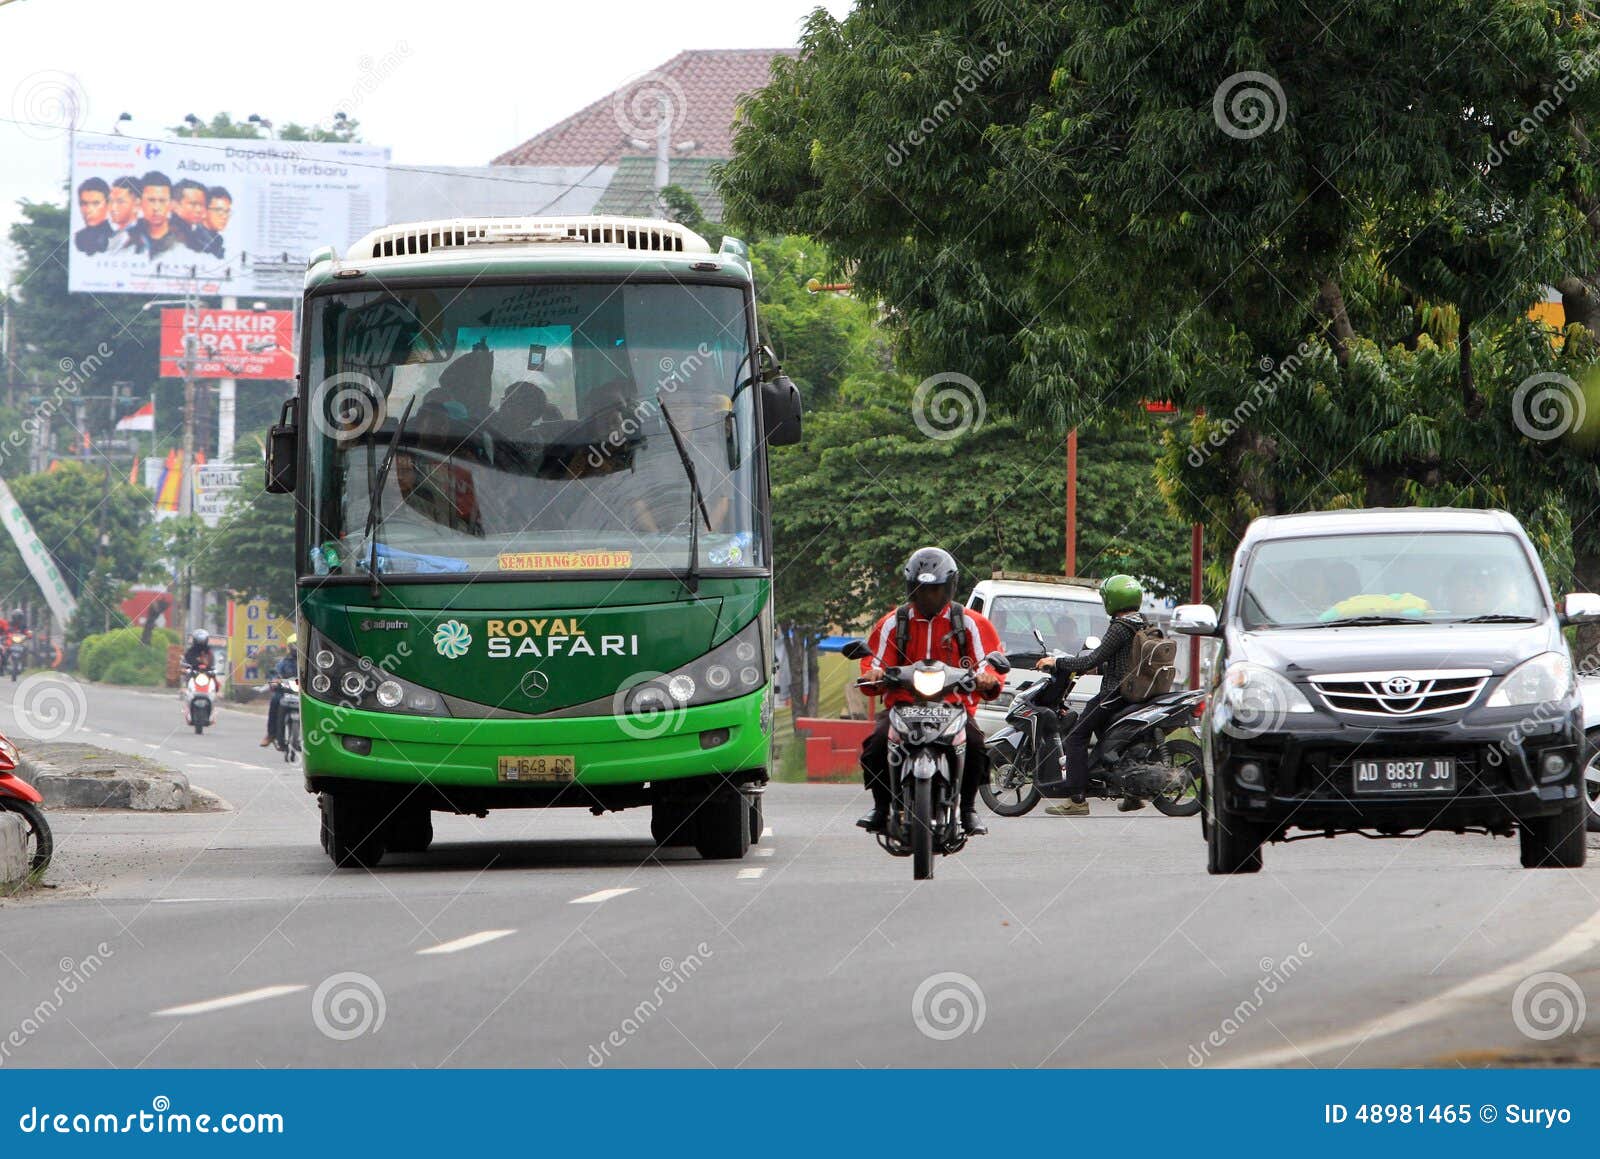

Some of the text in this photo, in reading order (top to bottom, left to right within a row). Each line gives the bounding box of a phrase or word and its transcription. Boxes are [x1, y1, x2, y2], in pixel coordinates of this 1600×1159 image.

[176, 159, 225, 174] Album
[292, 163, 348, 178] Terbaru
[183, 314, 276, 333] PARKIR
[614, 554, 630, 567] PP
[487, 618, 585, 637] ROYAL
[488, 635, 639, 658] SAFARI
[500, 760, 508, 776] H
[518, 759, 546, 773] 1648
[1360, 761, 1449, 781] AD 8837 JU
